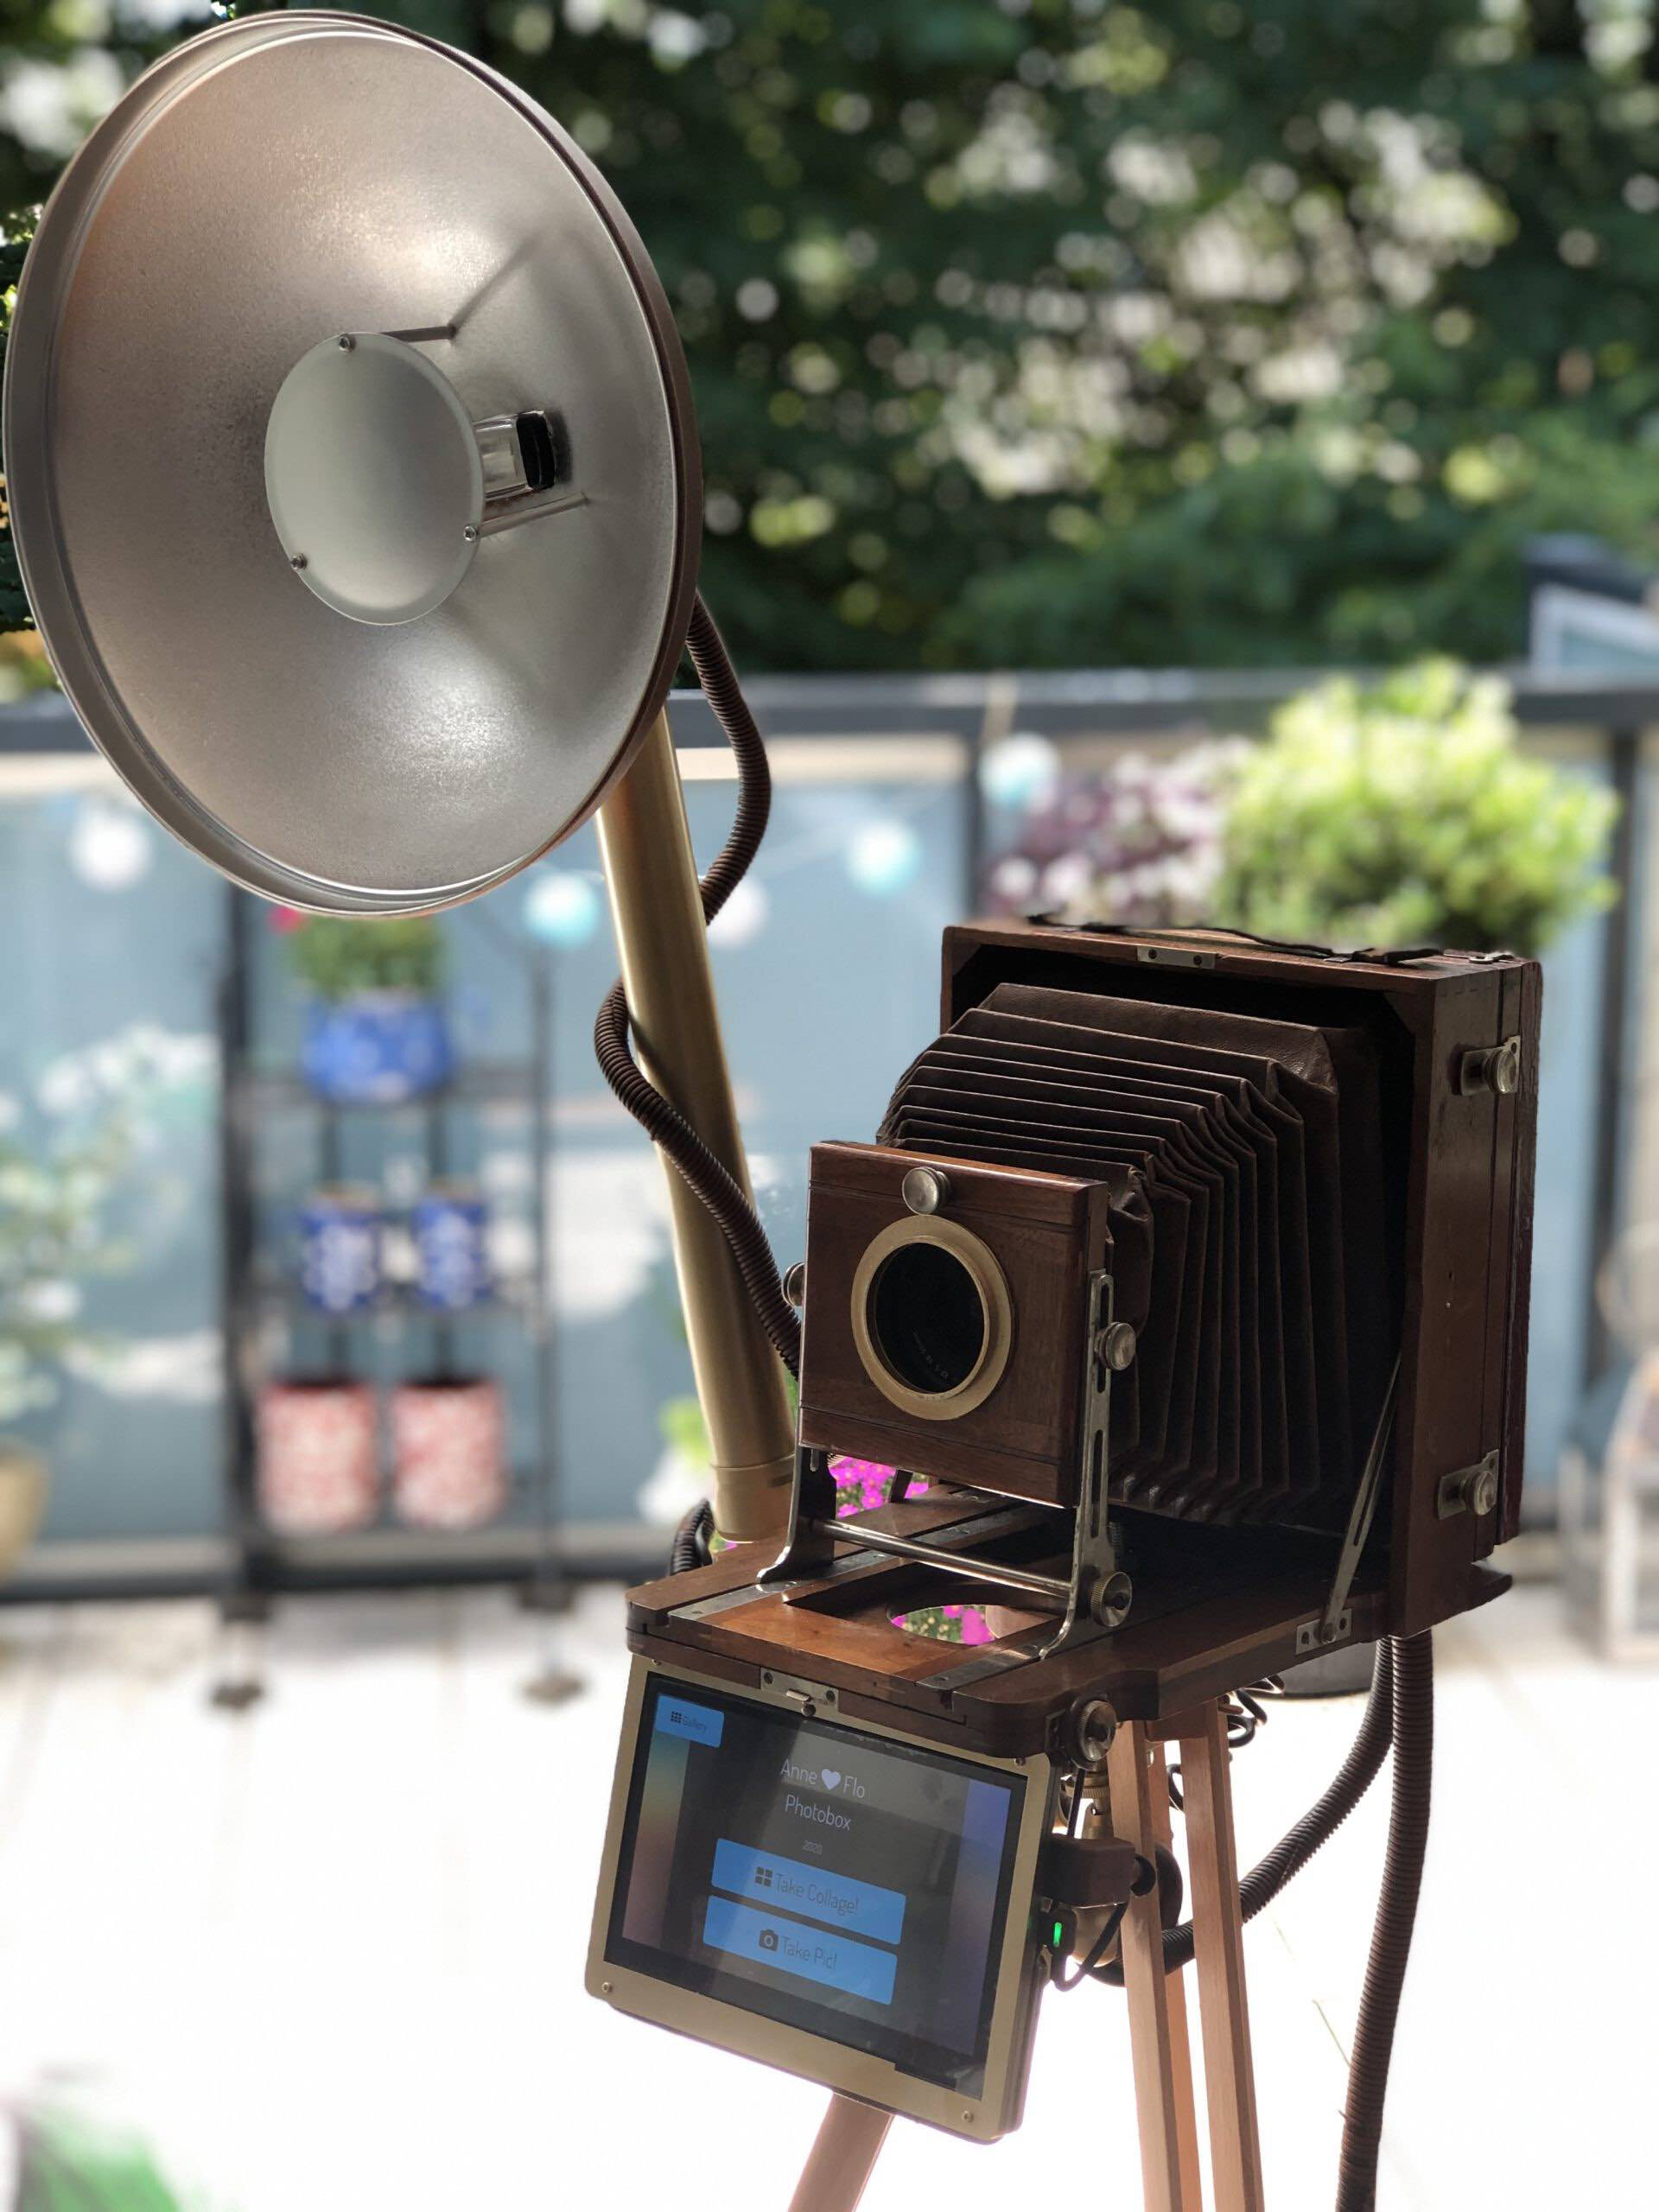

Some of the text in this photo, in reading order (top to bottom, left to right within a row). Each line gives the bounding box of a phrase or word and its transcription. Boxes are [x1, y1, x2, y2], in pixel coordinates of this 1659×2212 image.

[780, 1758, 865, 1798] Anne Flo
[785, 1794, 851, 1831] Photobox
[776, 1873, 859, 1915] Take Collage!
[781, 1936, 837, 1970] Take Pic!
